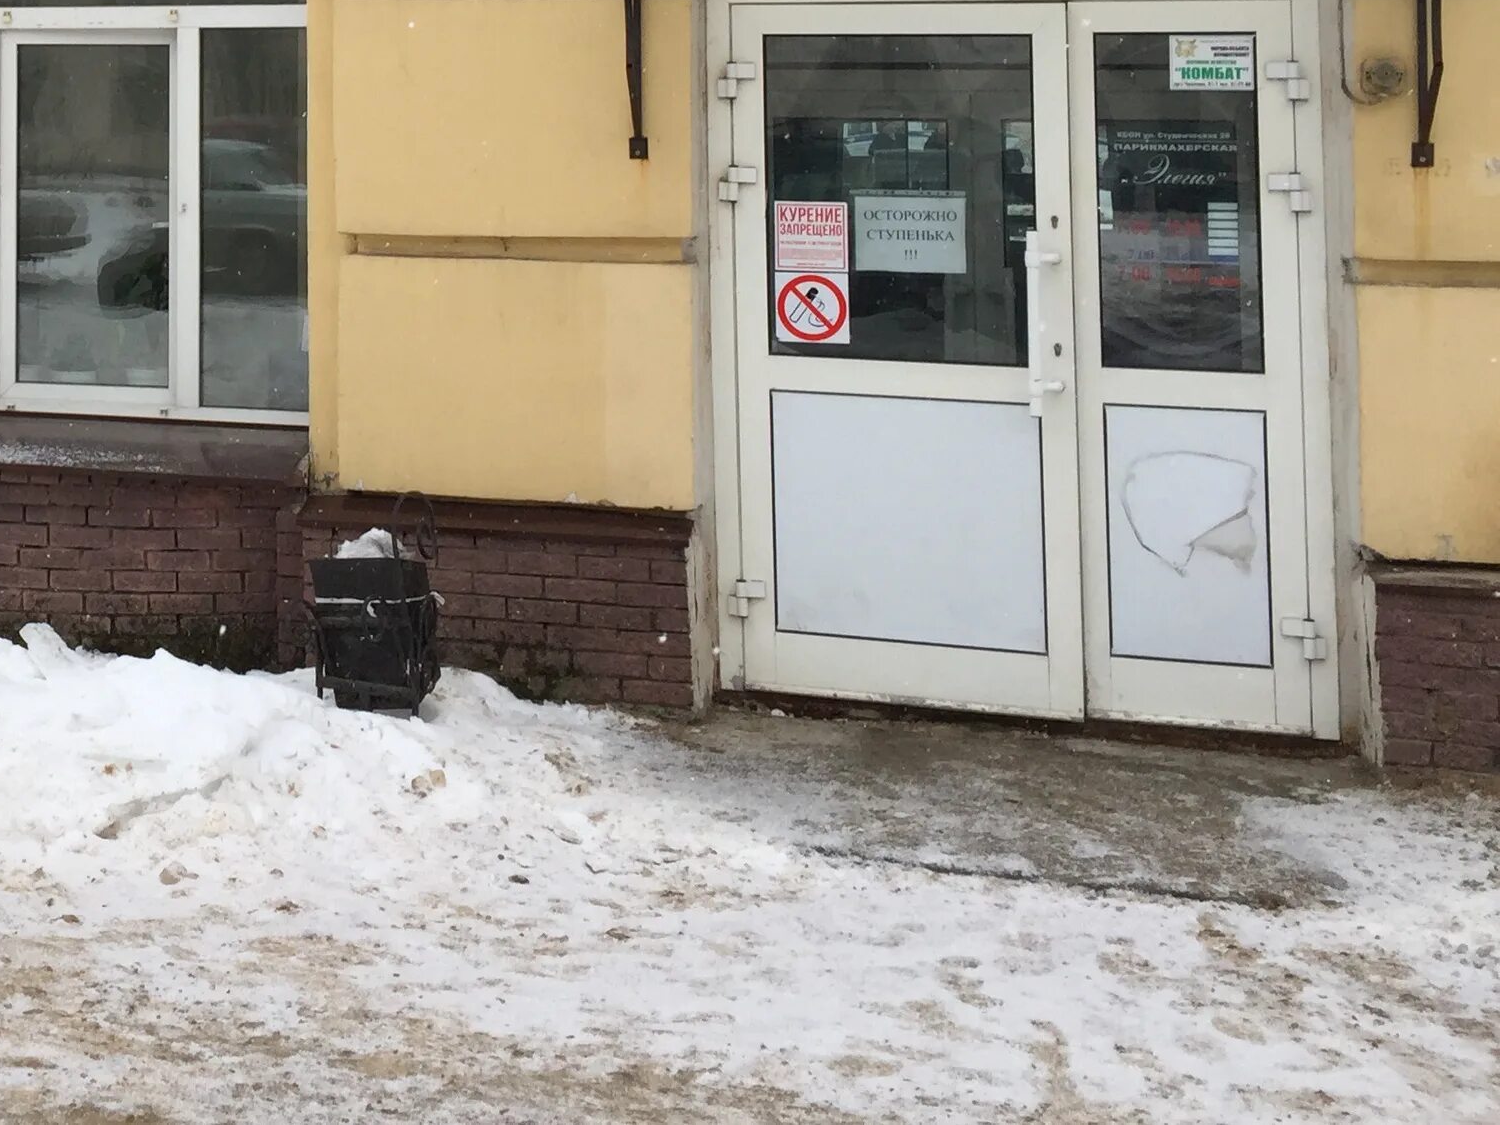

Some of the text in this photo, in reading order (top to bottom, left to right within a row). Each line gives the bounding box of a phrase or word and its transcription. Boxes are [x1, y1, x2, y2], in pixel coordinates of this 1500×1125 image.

[1113, 142, 1238, 152] ПАРИКМАХЕРСКАЯ
[779, 206, 842, 223] КУРЕНИЕ
[863, 209, 958, 222] ОСТОРОЖНО
[779, 222, 843, 238] ЗАПРЕЩЕНО
[866, 228, 955, 242] СТУПЕНЬКА
